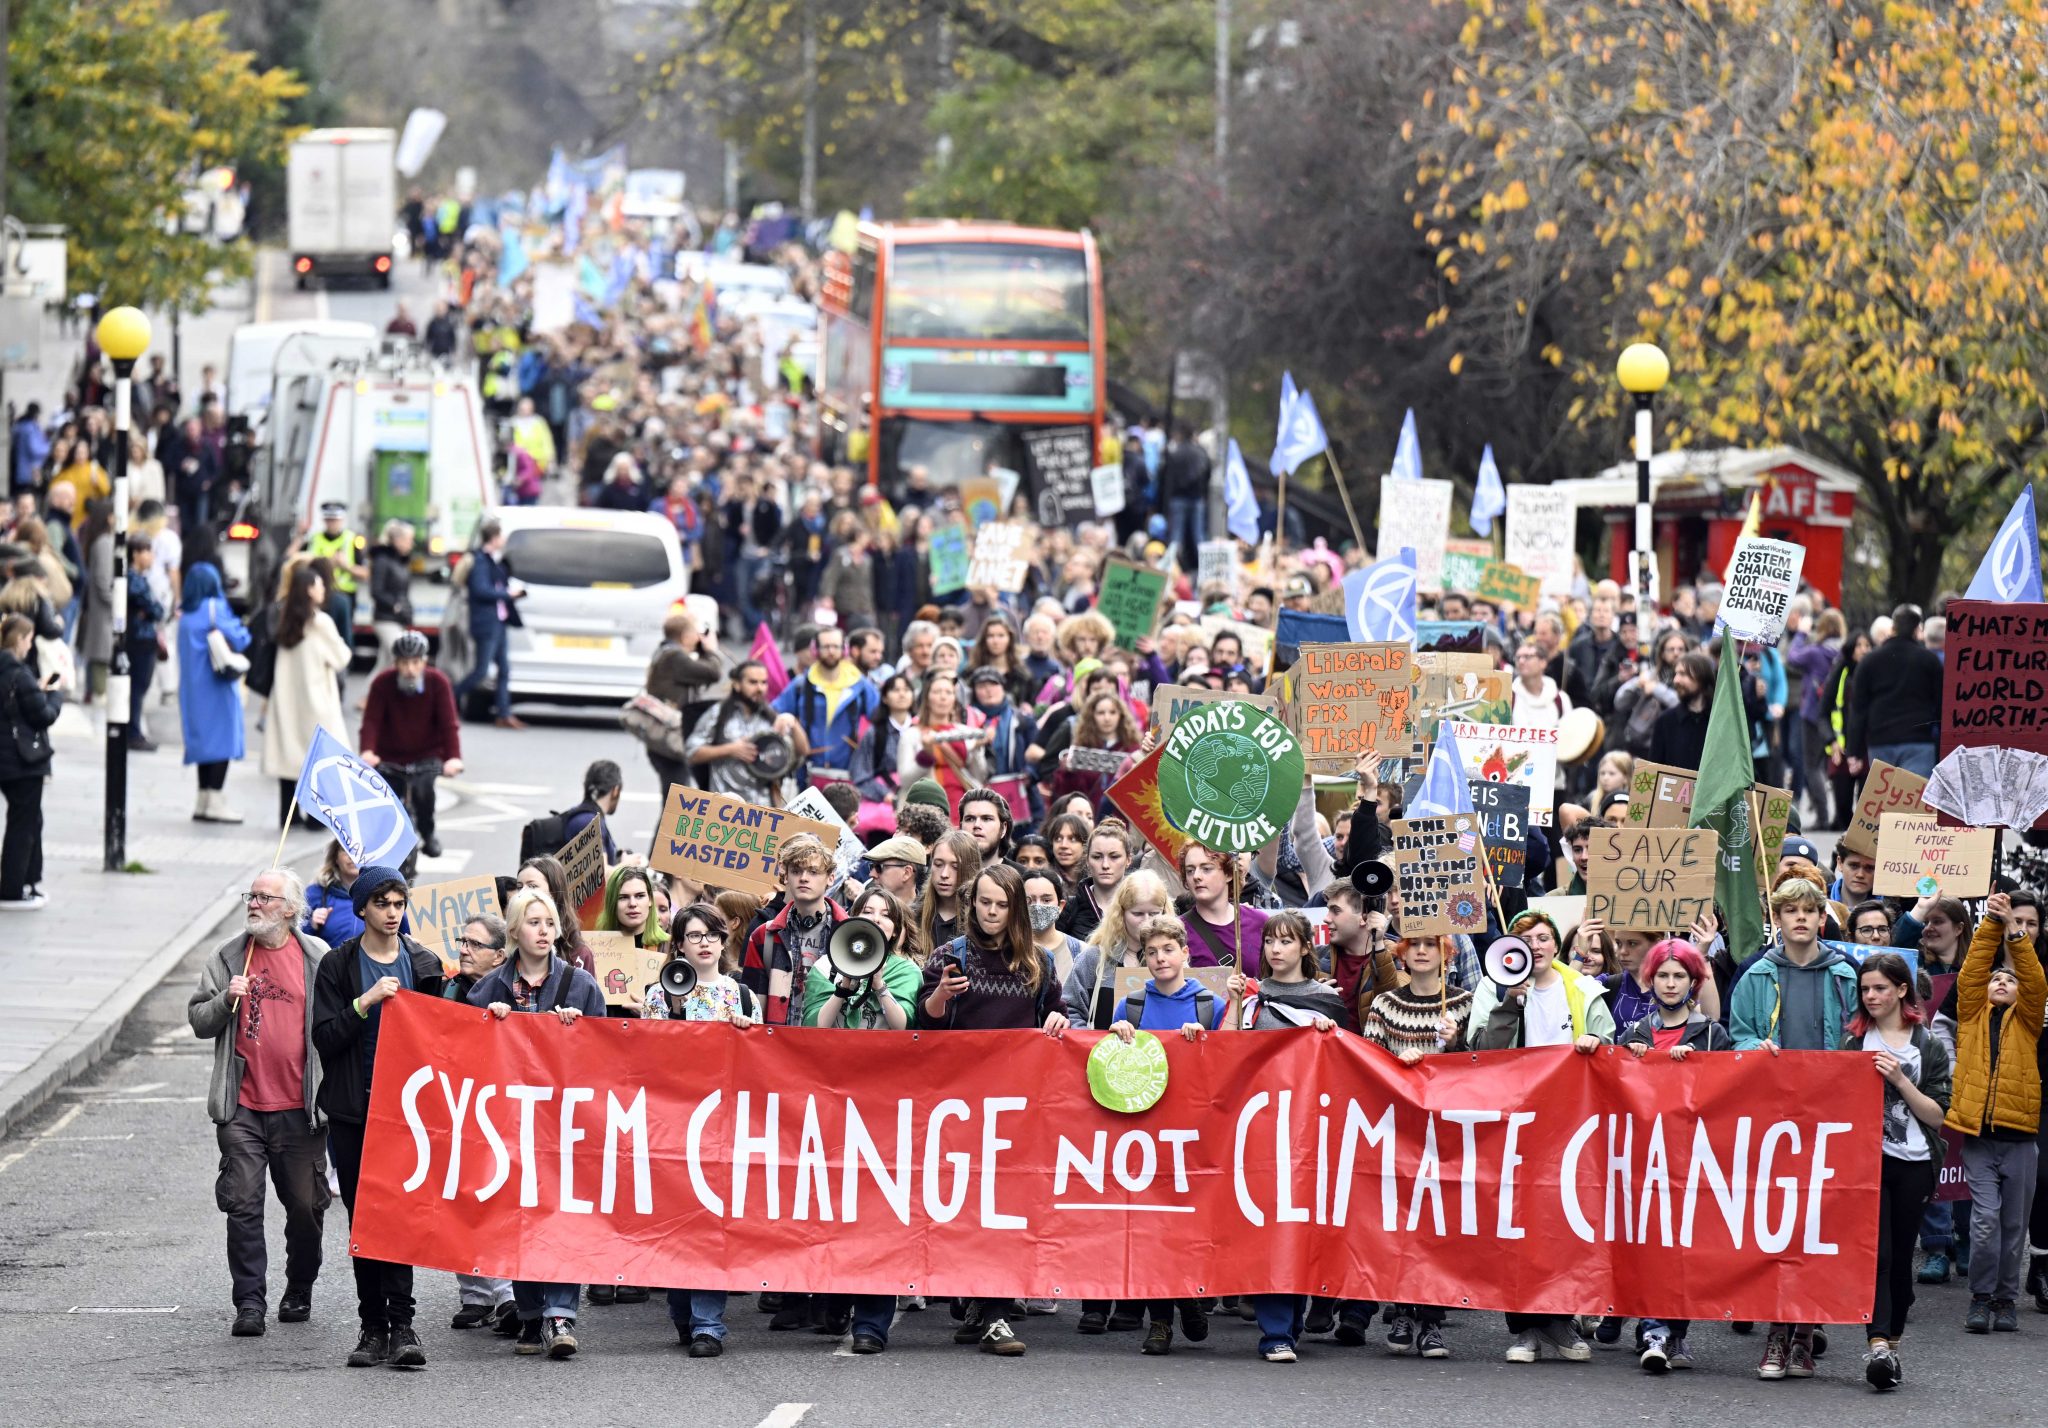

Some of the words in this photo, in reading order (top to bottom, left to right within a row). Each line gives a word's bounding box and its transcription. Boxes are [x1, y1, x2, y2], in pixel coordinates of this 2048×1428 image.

[1735, 563, 1792, 581] CHANGE
[1738, 551, 1791, 569] SYSTEM
[966, 558, 1028, 591] LANET
[1732, 574, 1759, 586] NOT
[1726, 598, 1784, 617] CHANGE
[1730, 586, 1788, 606] CLIMATE
[1947, 611, 2028, 637] WHAT'S
[2033, 618, 2048, 637] M
[1306, 648, 1405, 674] Liberals
[1957, 647, 2048, 671] FUTUR
[1308, 678, 1376, 699] Won't
[1956, 677, 2044, 701] WORLD
[1165, 705, 1246, 761] FRIDAYS
[1251, 717, 1293, 761] FOR
[1488, 726, 1558, 743] POPPIES
[1657, 777, 1697, 804] EA
[678, 794, 711, 816] WE
[718, 803, 785, 832] CAN'T
[675, 814, 779, 855] RECYCLE
[1184, 808, 1277, 850] FUTURE
[1408, 819, 1446, 833] THE
[1602, 832, 1700, 866] SAVE
[1914, 834, 1956, 846] FUTURE
[670, 839, 750, 870] WASTED
[1400, 856, 1477, 875] GETTING
[1419, 848, 1437, 861] IS
[1920, 848, 1950, 862] NOT
[566, 854, 592, 883] mazon
[1616, 866, 1677, 893] OUR
[1883, 860, 1921, 875] FOSSIL
[1933, 863, 1970, 876] FUELS
[407, 886, 498, 931] WAKE
[1400, 890, 1448, 903] THAN
[1403, 903, 1439, 918] ME!
[1592, 894, 1711, 928] PLANET
[441, 926, 466, 961] U
[401, 1064, 653, 1215] SYSTEM
[686, 1088, 1028, 1229] CHANGE
[1053, 1128, 1200, 1196] NOT
[1234, 1089, 1537, 1240] CLiMATE
[1560, 1112, 1853, 1255] CHANGE
